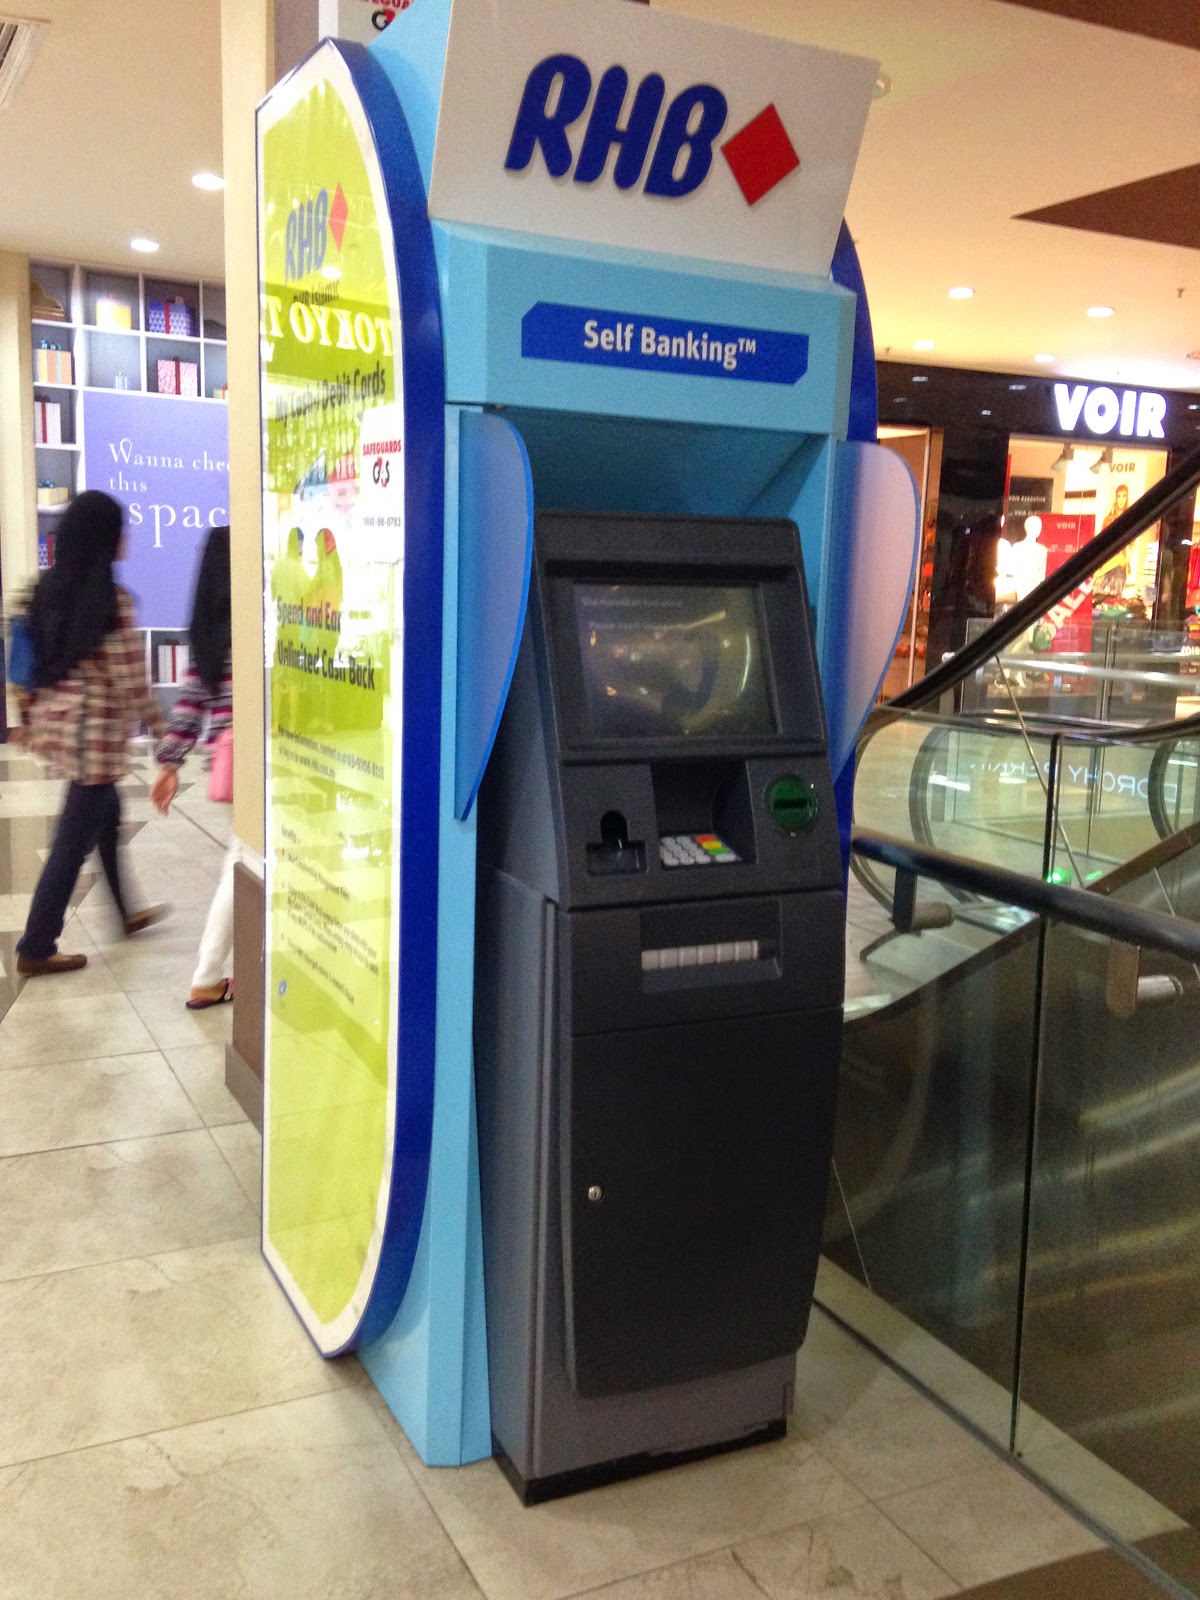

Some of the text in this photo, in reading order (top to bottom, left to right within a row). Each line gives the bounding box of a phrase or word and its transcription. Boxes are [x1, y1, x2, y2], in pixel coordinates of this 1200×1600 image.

[504, 53, 728, 197] RHB
[284, 187, 329, 287] RHB
[583, 319, 635, 353] Self
[321, 371, 351, 411] Debit
[353, 360, 386, 401] Cards
[1054, 383, 1167, 438] VOIR
[108, 438, 184, 469] Wanna
[362, 438, 402, 456] SAFEGUARDS
[109, 471, 148, 492] this
[1110, 462, 1136, 473] VOIR
[276, 595, 304, 629] Spend
[306, 599, 323, 630] and
[277, 639, 375, 691] Unlimited Cash Back
